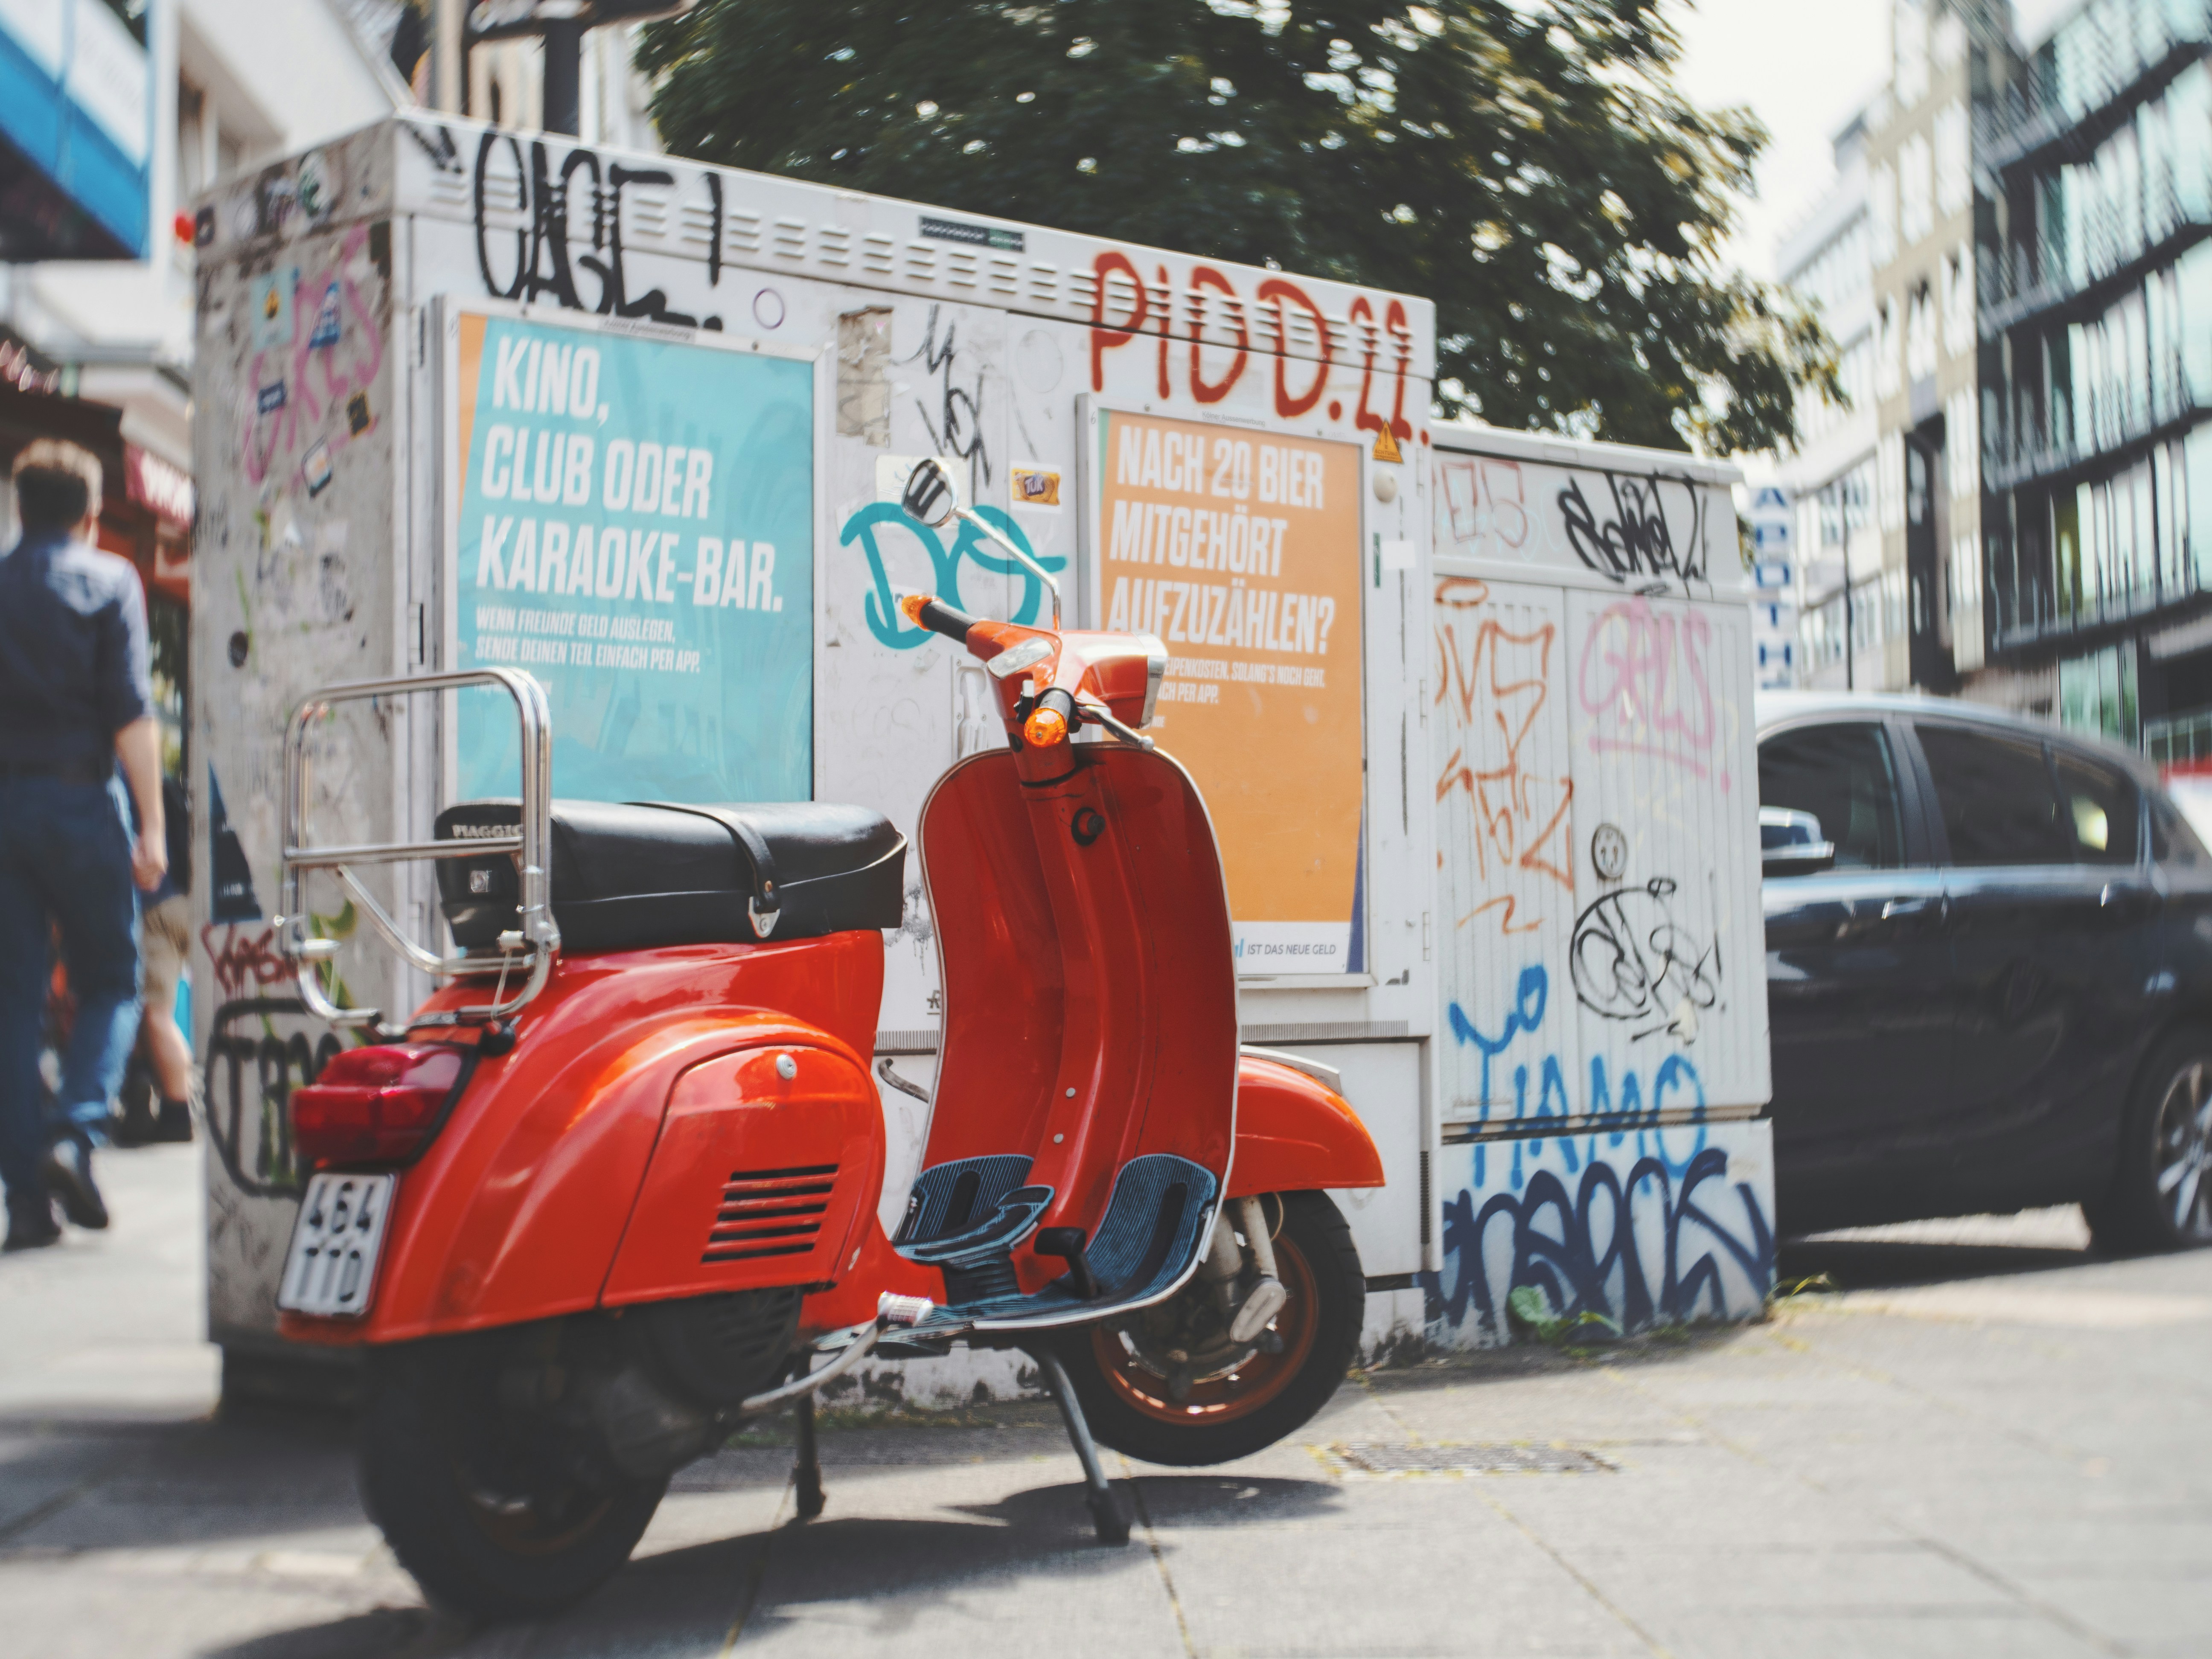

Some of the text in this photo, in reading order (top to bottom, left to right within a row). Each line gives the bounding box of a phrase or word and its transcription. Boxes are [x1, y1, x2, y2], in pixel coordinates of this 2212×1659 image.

[492, 335, 609, 427] KINO,
[1202, 410, 1220, 420] Kölner
[1222, 413, 1266, 428] Aussenwerbung
[481, 425, 713, 519] CLUB ODER
[1117, 425, 1325, 509] NACH 20 BIER
[476, 514, 783, 613] KARAOKE-BAR.
[1109, 499, 1288, 577] MITGEHÖRT
[476, 605, 515, 631] WENN
[518, 608, 576, 637] FREUNDE
[578, 613, 609, 638] GELD
[1106, 576, 1335, 655] AUFZUZÄHLEN?
[1755, 486, 1792, 690] APOTH
[475, 634, 700, 673] SENDE DEINEN TEIL EINFACH PER APP.
[1277, 666, 1302, 685] NOCH
[1177, 683, 1196, 702] PER
[1196, 684, 1219, 704] APP.
[1247, 944, 1262, 955] IST
[1264, 944, 1284, 955] DAS
[1286, 944, 1310, 955] NEUE
[1312, 944, 1336, 955] GELD
